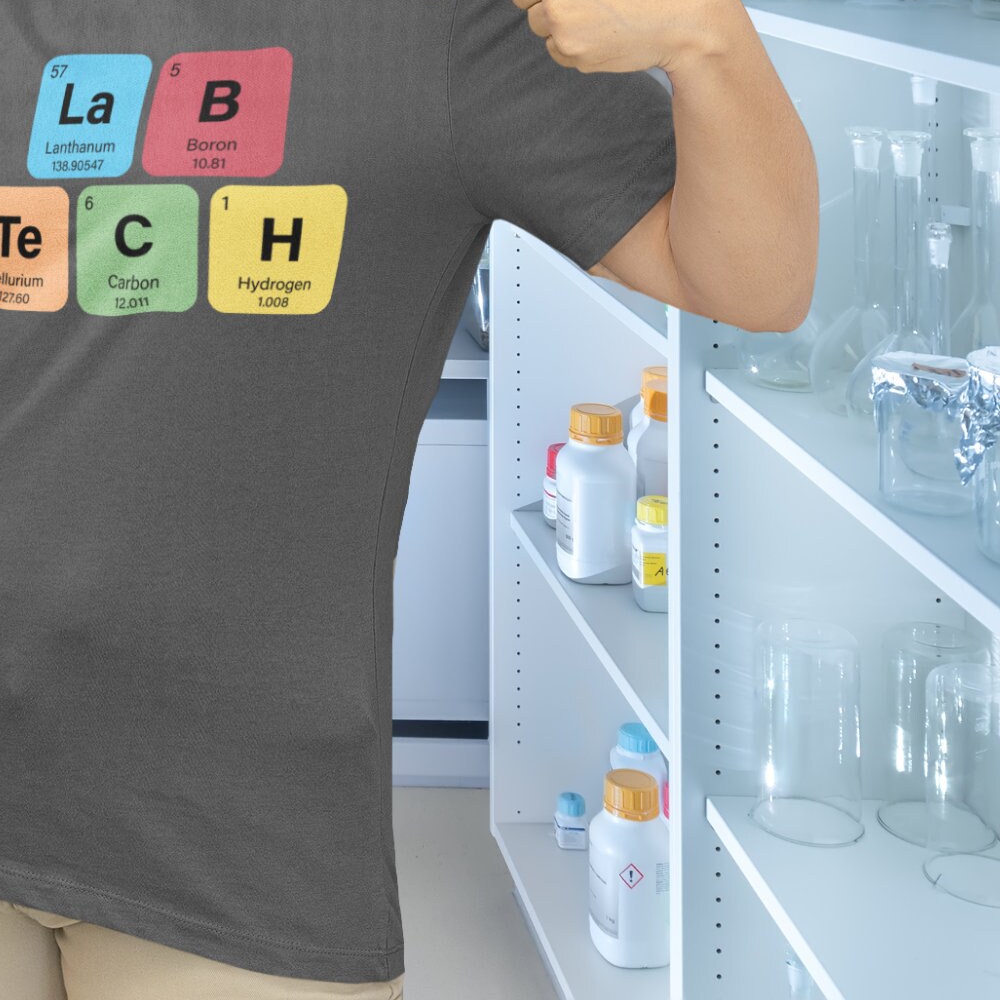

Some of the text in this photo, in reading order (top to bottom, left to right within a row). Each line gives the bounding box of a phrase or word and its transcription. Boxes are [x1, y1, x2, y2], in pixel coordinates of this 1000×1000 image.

[50, 64, 68, 79] 57
[169, 63, 181, 77] 5
[58, 82, 115, 126] La
[198, 79, 242, 123] B
[44, 139, 116, 155] Lanthanum
[186, 137, 238, 152] Boron
[52, 159, 105, 172] 138.90547
[192, 158, 226, 170] 10.81
[84, 195, 94, 210] 6
[221, 195, 229, 210] 1
[114, 214, 154, 258] C
[260, 217, 304, 262] H
[107, 274, 160, 290] Carbon
[238, 276, 312, 293] Hydrogen
[115, 297, 150, 309] 12.011
[258, 297, 290, 308] 1.008
